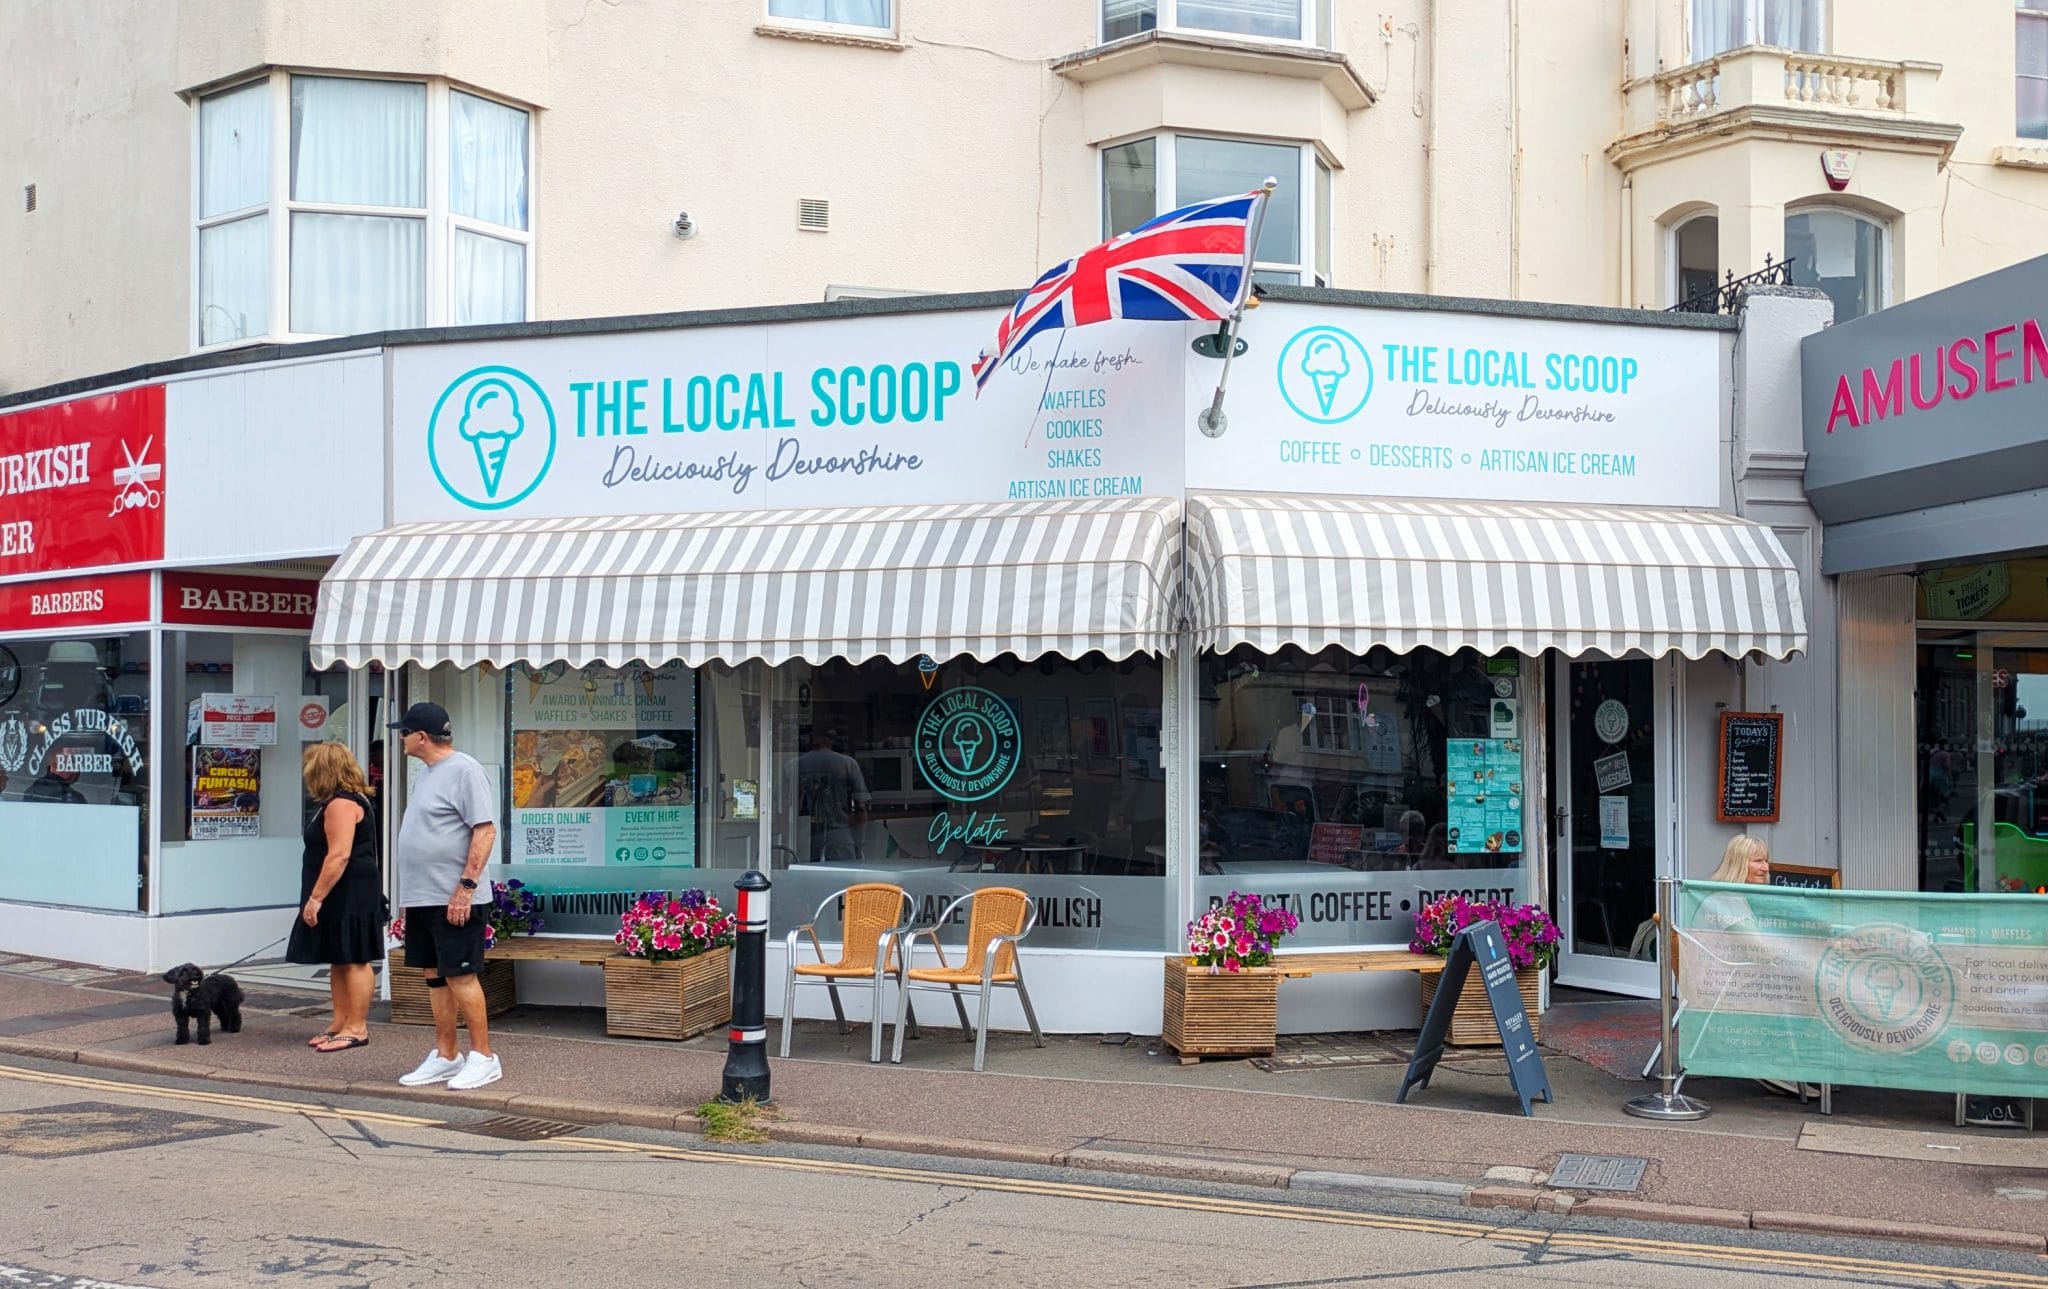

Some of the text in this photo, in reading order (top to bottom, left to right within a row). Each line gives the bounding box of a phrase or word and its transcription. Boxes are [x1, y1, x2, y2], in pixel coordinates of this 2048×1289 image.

[1010, 345, 1039, 375] We
[1044, 350, 1090, 370] make
[1382, 344, 1639, 394] THE LOCAL SCOOP
[569, 361, 961, 438] THE LOCAL SCOOP
[1044, 389, 1106, 410] WAFFLES
[1405, 389, 1616, 428] Deliciously Devonshire
[1046, 419, 1103, 439] COOKIES
[603, 438, 923, 494] Deliciously Devonshire
[1047, 448, 1102, 468] SHAKES
[1280, 440, 1637, 477] COFFEE DESSERTS ARTISAN ICE CREAM
[1008, 476, 1142, 499] ARTISAN ICE CREAM
[31, 588, 104, 616] BARBERS
[180, 587, 315, 616] BARBER
[1955, 584, 1990, 610] TICKETS
[542, 694, 577, 706] AWARD
[618, 694, 633, 706] ICE
[534, 710, 673, 722] WAFFLES SHAKES COFFEE
[922, 692, 1014, 738] THE LOCAL SCOOP
[28, 708, 144, 777] CLASS TURKISH
[56, 754, 113, 773] BARBER
[209, 767, 249, 777] CIRCUS
[925, 752, 1011, 792] DELICIOUSLY DEVONSHIRE
[198, 777, 257, 792] FUNTASIA
[521, 812, 592, 825] ORDER ONLINE
[625, 810, 680, 823] EVENT HIRE
[928, 810, 1008, 854] Gelato
[1031, 897, 1101, 927] WLISH
[1310, 891, 1393, 923] COFFEE
[1991, 927, 2032, 941] WAFFLES
[1965, 957, 1984, 968] For
[1988, 958, 2016, 969] local
[1970, 985, 2029, 996] and order
[1828, 996, 1941, 1044] DELICIOUSLY DEVONSHIRE
